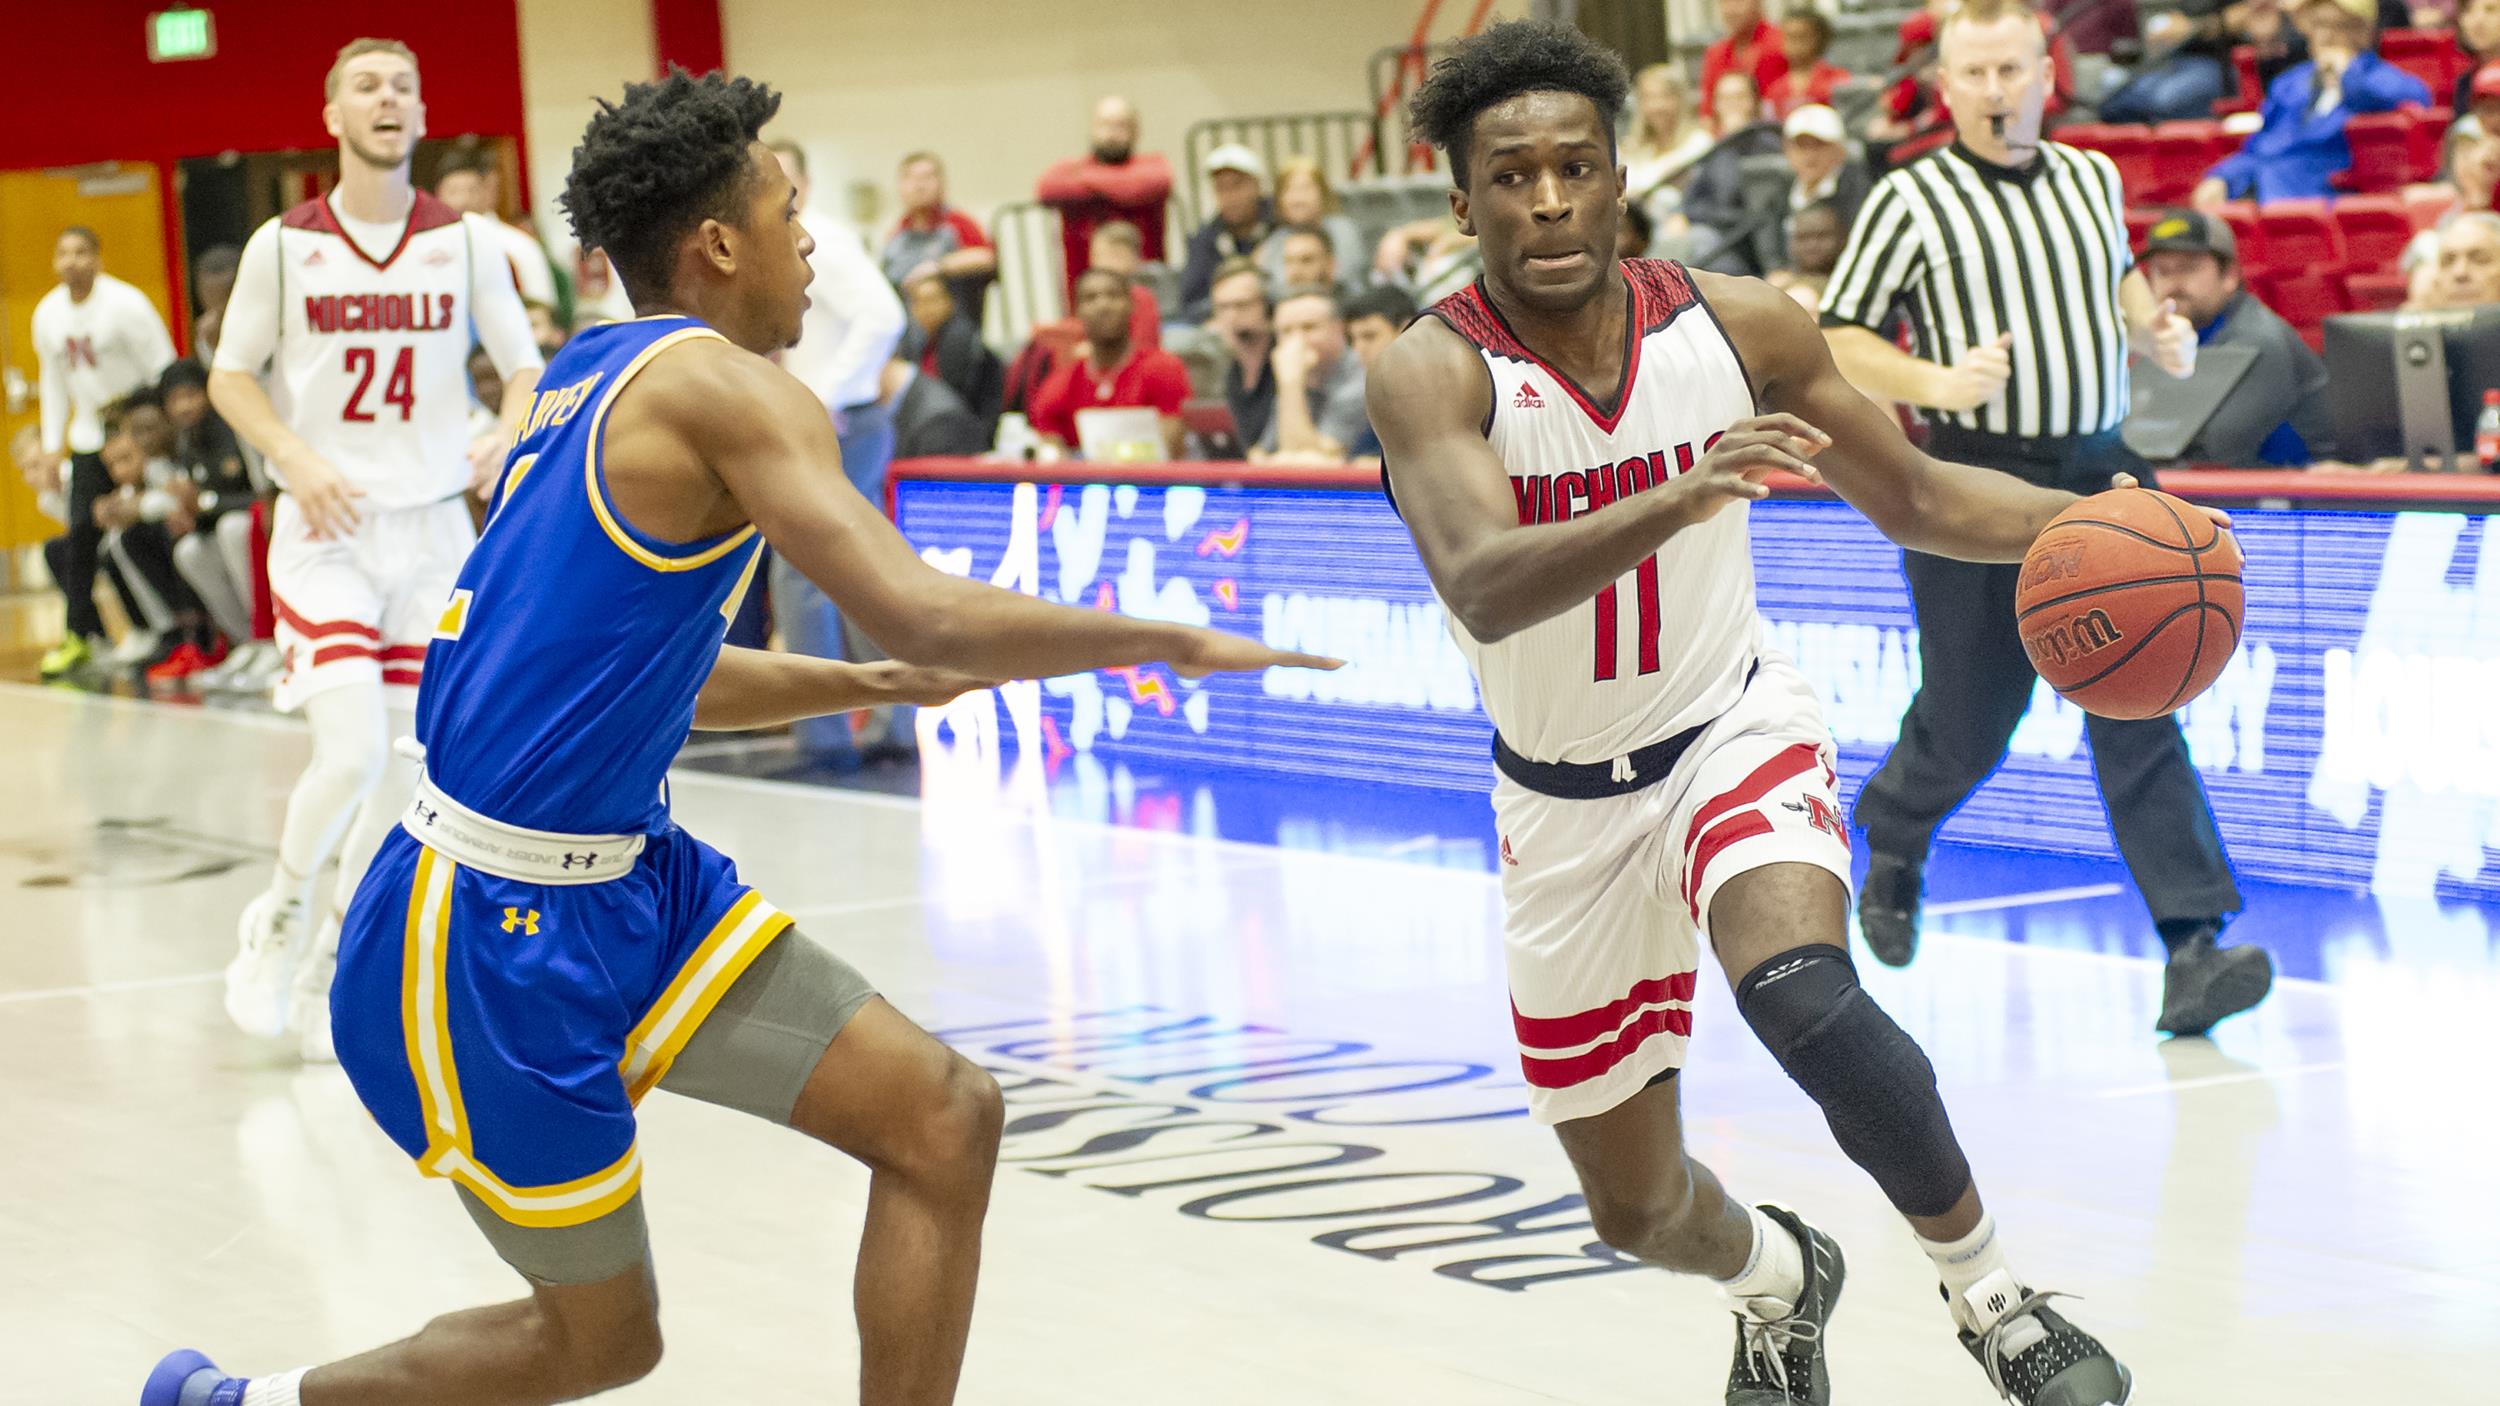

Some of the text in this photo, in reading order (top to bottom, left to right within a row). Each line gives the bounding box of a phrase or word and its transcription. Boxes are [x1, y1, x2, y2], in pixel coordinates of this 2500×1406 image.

[305, 292, 454, 334] NICHOLLS
[342, 346, 416, 422] 24
[512, 371, 604, 449] ARVEY
[1594, 551, 1662, 683] 11
